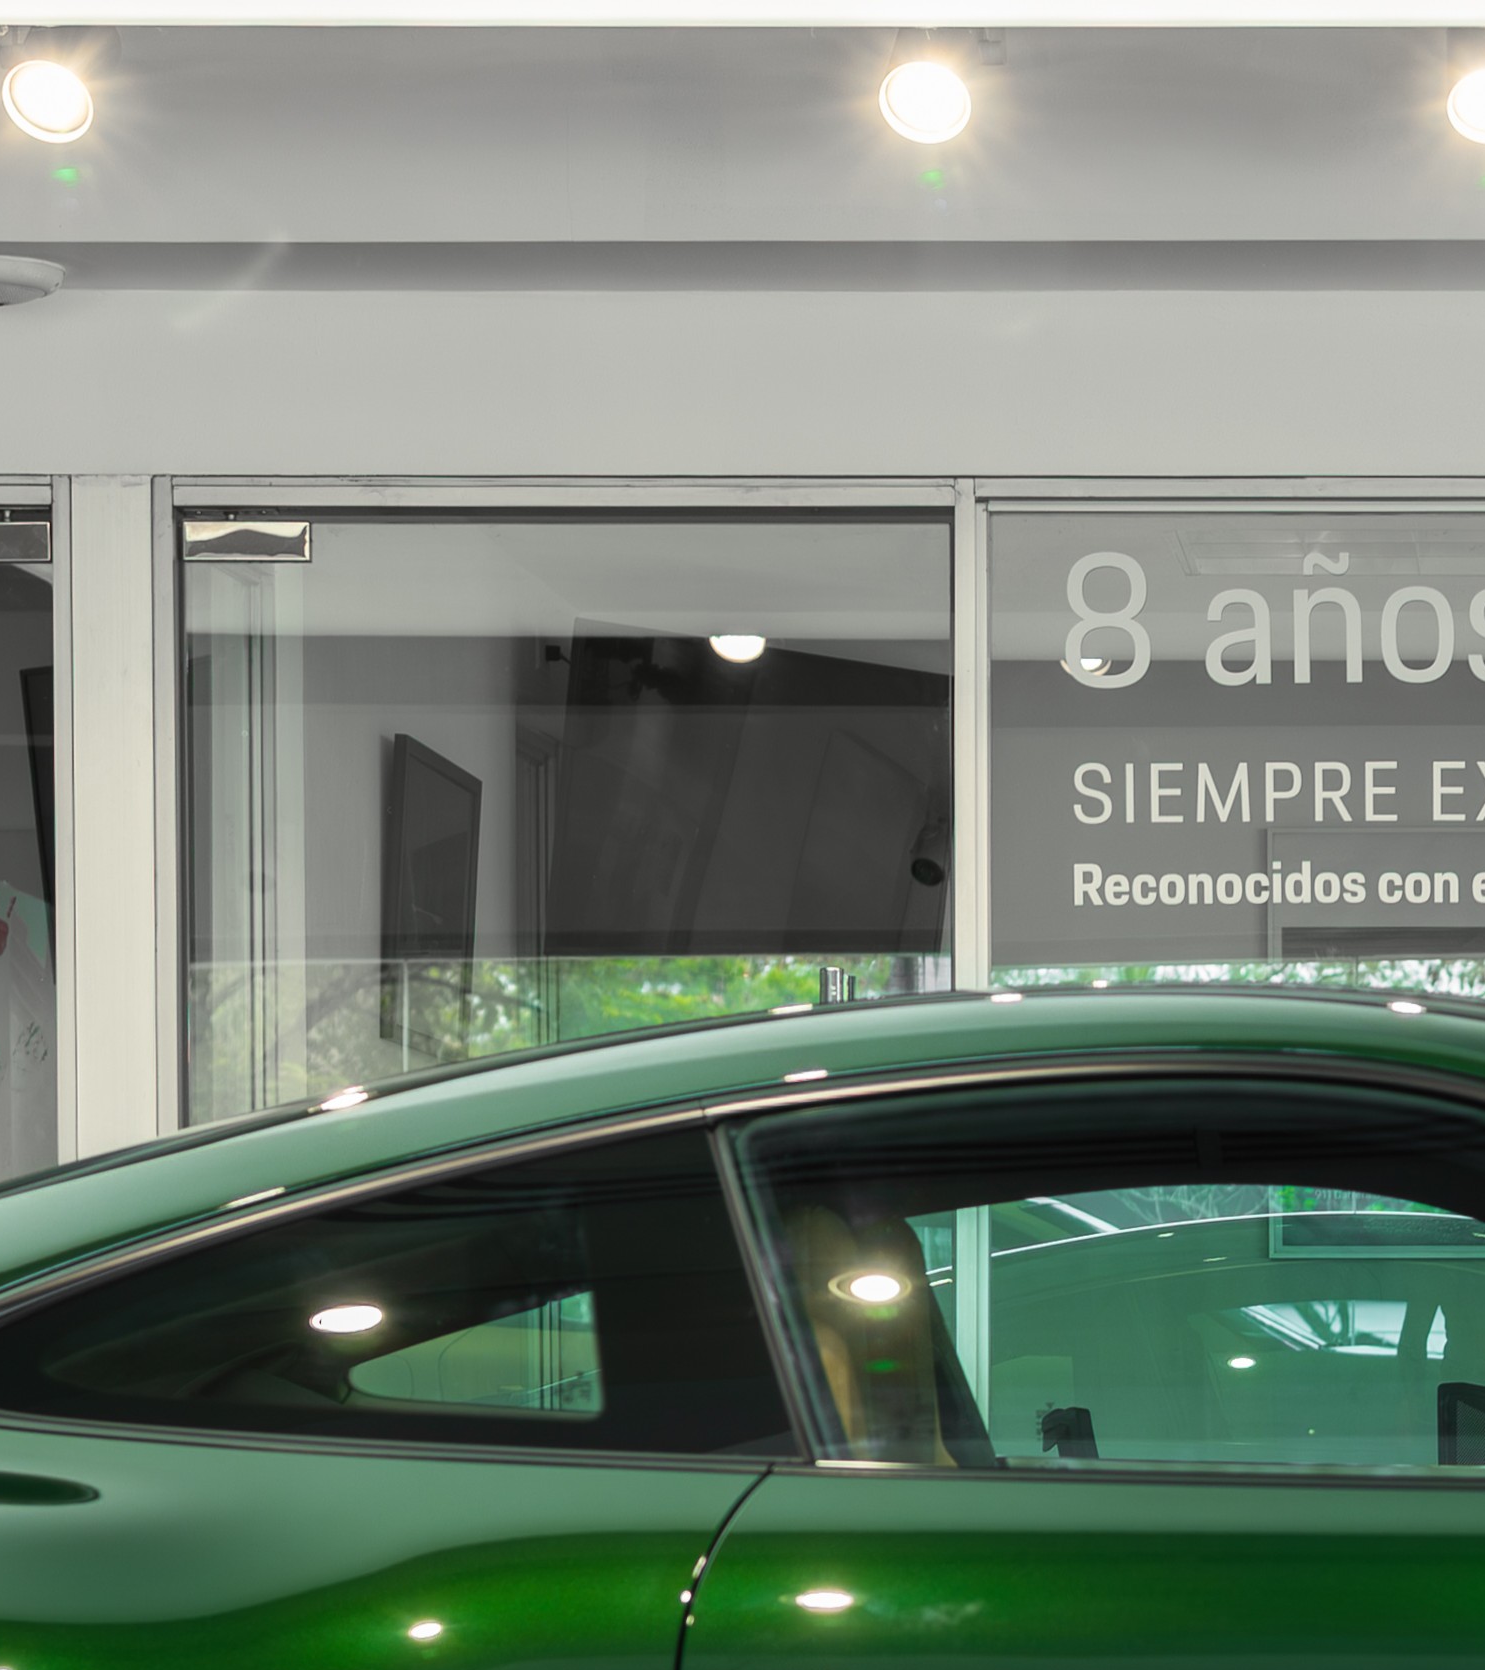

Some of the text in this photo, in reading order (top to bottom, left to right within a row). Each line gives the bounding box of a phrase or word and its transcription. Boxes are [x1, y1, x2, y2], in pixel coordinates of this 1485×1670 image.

[1064, 551, 1152, 690] 8
[1072, 761, 1399, 825] SIEMPRE
[1072, 862, 1367, 907] Reconocidos
[1377, 869, 1461, 904] con
